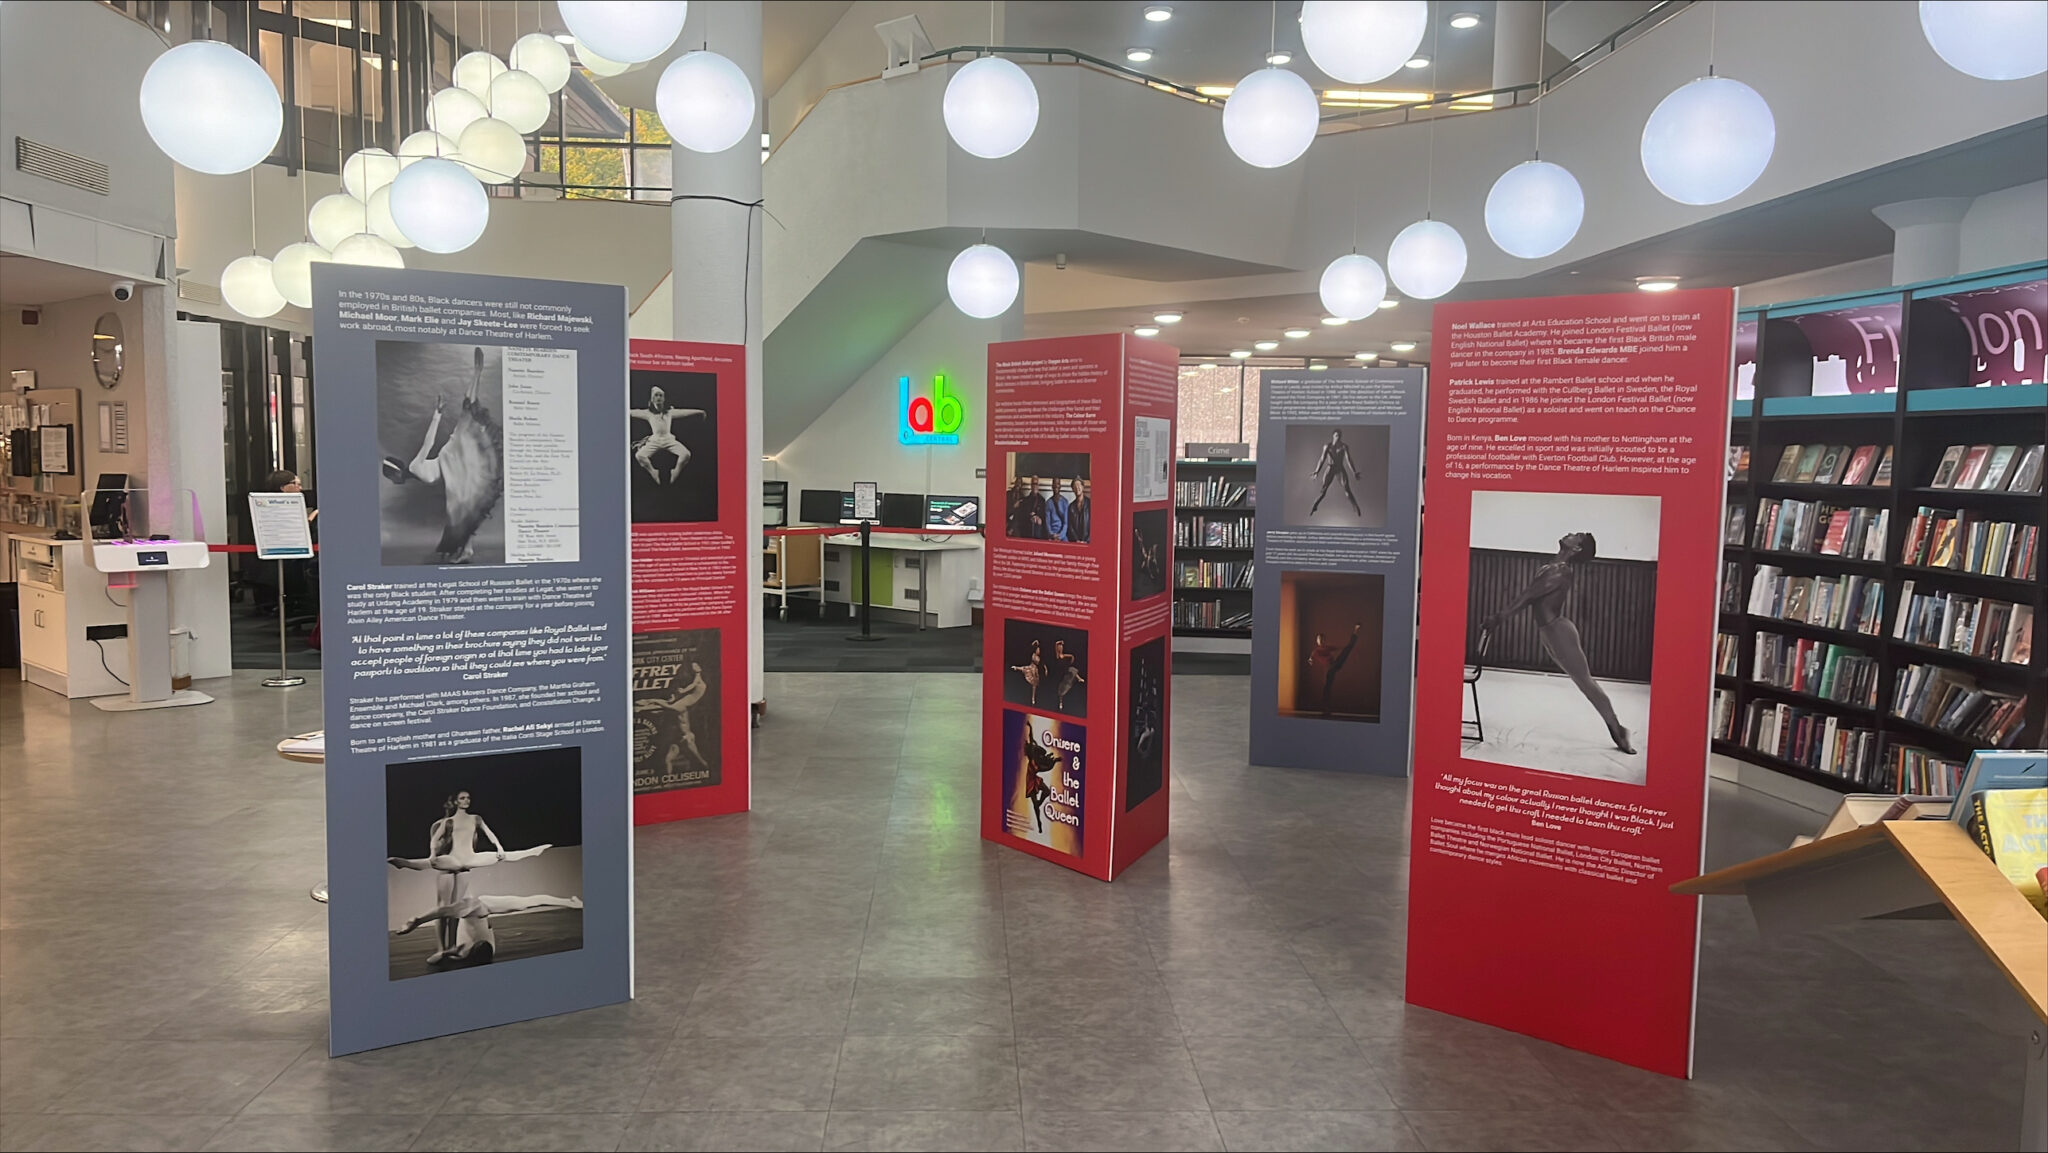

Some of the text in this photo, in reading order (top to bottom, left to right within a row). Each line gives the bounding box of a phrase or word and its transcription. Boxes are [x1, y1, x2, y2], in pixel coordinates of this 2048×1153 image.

[348, 291, 363, 299] the
[364, 292, 391, 300] 1970s
[392, 294, 408, 302] and
[409, 295, 427, 304] 80s,
[428, 296, 450, 304] Black
[451, 297, 483, 306] dancers
[505, 300, 518, 308] still
[534, 302, 572, 314] commonly
[338, 302, 380, 313] employed
[391, 304, 418, 313] British
[419, 306, 441, 314] ballet
[527, 312, 556, 320] Richard
[557, 313, 593, 324] Majewski,
[339, 311, 374, 320] Michael
[375, 313, 399, 322] Moor,
[401, 314, 422, 323] Mark
[441, 316, 456, 324] and
[458, 317, 472, 328] Jay
[539, 322, 563, 331] forced
[573, 324, 589, 332] seek
[339, 321, 360, 330] work
[362, 323, 394, 332] abroad,
[395, 324, 416, 333] most
[418, 326, 447, 336] notably
[458, 328, 483, 336] Dance
[485, 329, 514, 338] Theatre
[1463, 330, 1492, 338] Houston
[1562, 327, 1585, 337] joined
[1586, 326, 1615, 334] London
[1616, 325, 1646, 333] Festival
[1672, 324, 1692, 334] (now
[1468, 321, 1496, 329] Wallace
[1497, 320, 1521, 328] trained
[1547, 317, 1584, 326] Education
[1585, 316, 1611, 324] School
[1450, 340, 1475, 350] English
[1476, 339, 1505, 347] National
[1506, 338, 1529, 348] Ballet)
[1494, 350, 1526, 358] company
[1639, 345, 1664, 354] joined
[898, 375, 963, 443] lab
[1208, 446, 1230, 454] Crime
[483, 671, 508, 679] Straker
[1042, 730, 1080, 752] Onisere
[1072, 756, 1080, 771] &
[662, 770, 710, 783] COLISEUM
[1063, 771, 1080, 789] the
[1050, 787, 1080, 808] Ballet
[1044, 804, 1079, 826] Queen
[1974, 799, 1984, 822] THE
[1545, 822, 1562, 830] Love
